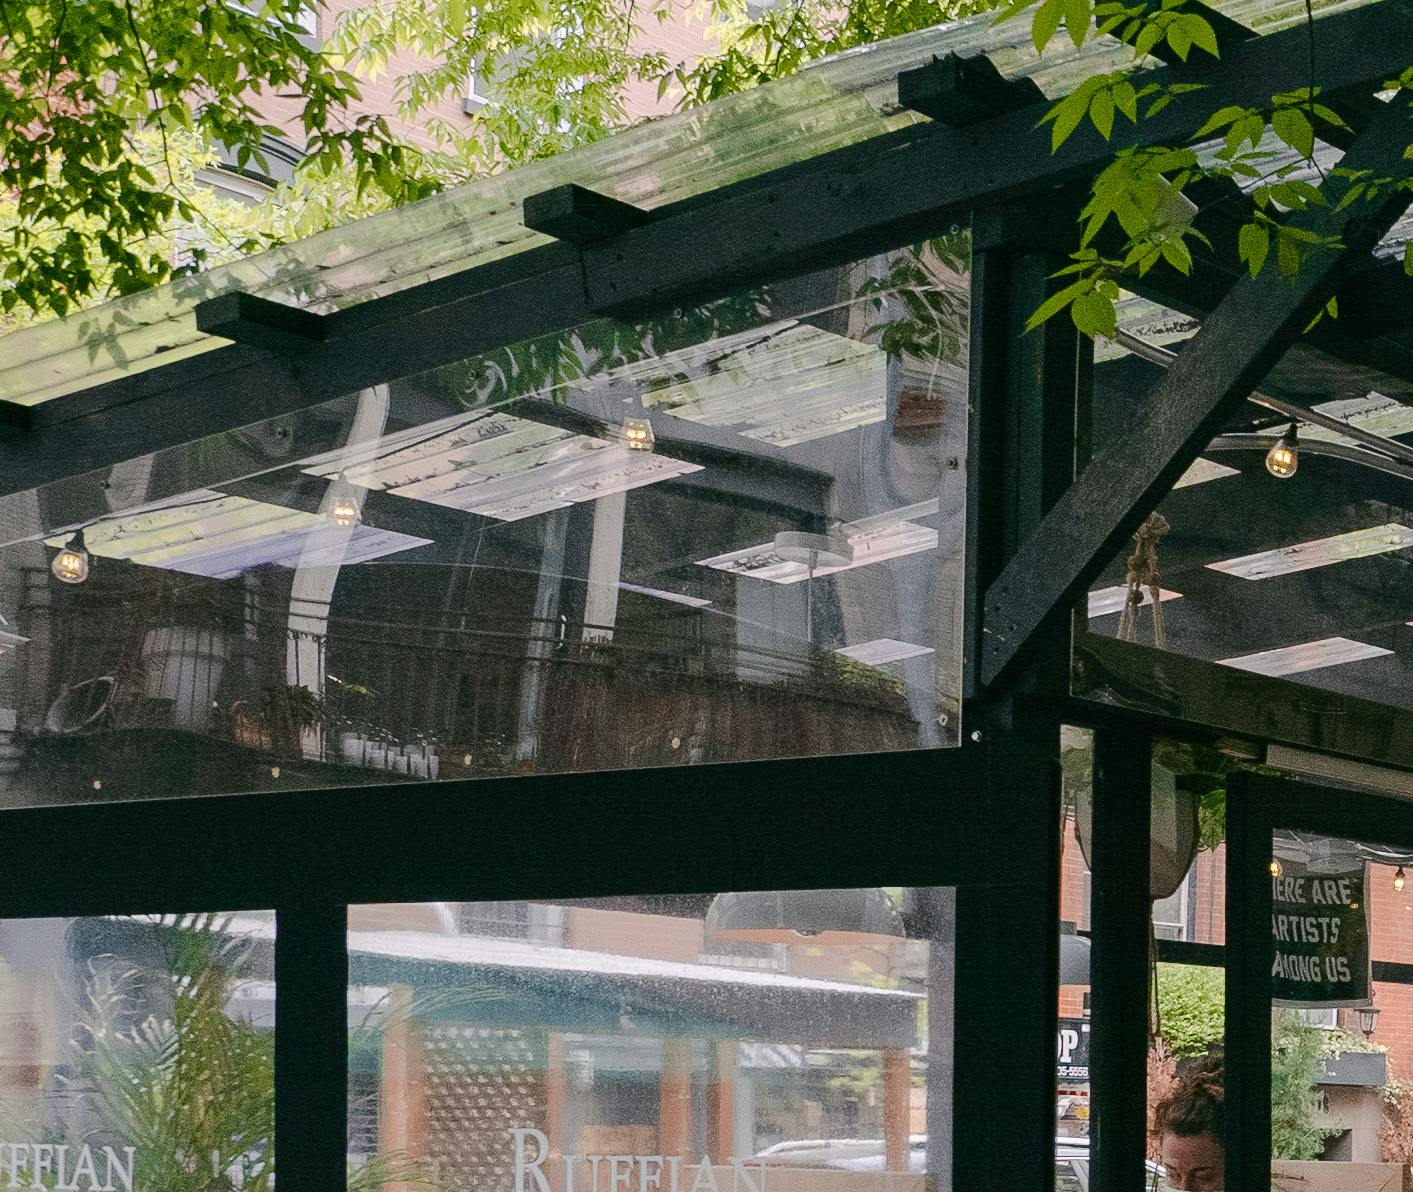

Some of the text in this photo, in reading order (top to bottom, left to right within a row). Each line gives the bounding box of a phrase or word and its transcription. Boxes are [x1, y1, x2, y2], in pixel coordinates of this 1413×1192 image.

[1312, 878, 1352, 905] ARE
[1272, 949, 1352, 983] AMONG US
[0, 1141, 137, 1192] FFIAN
